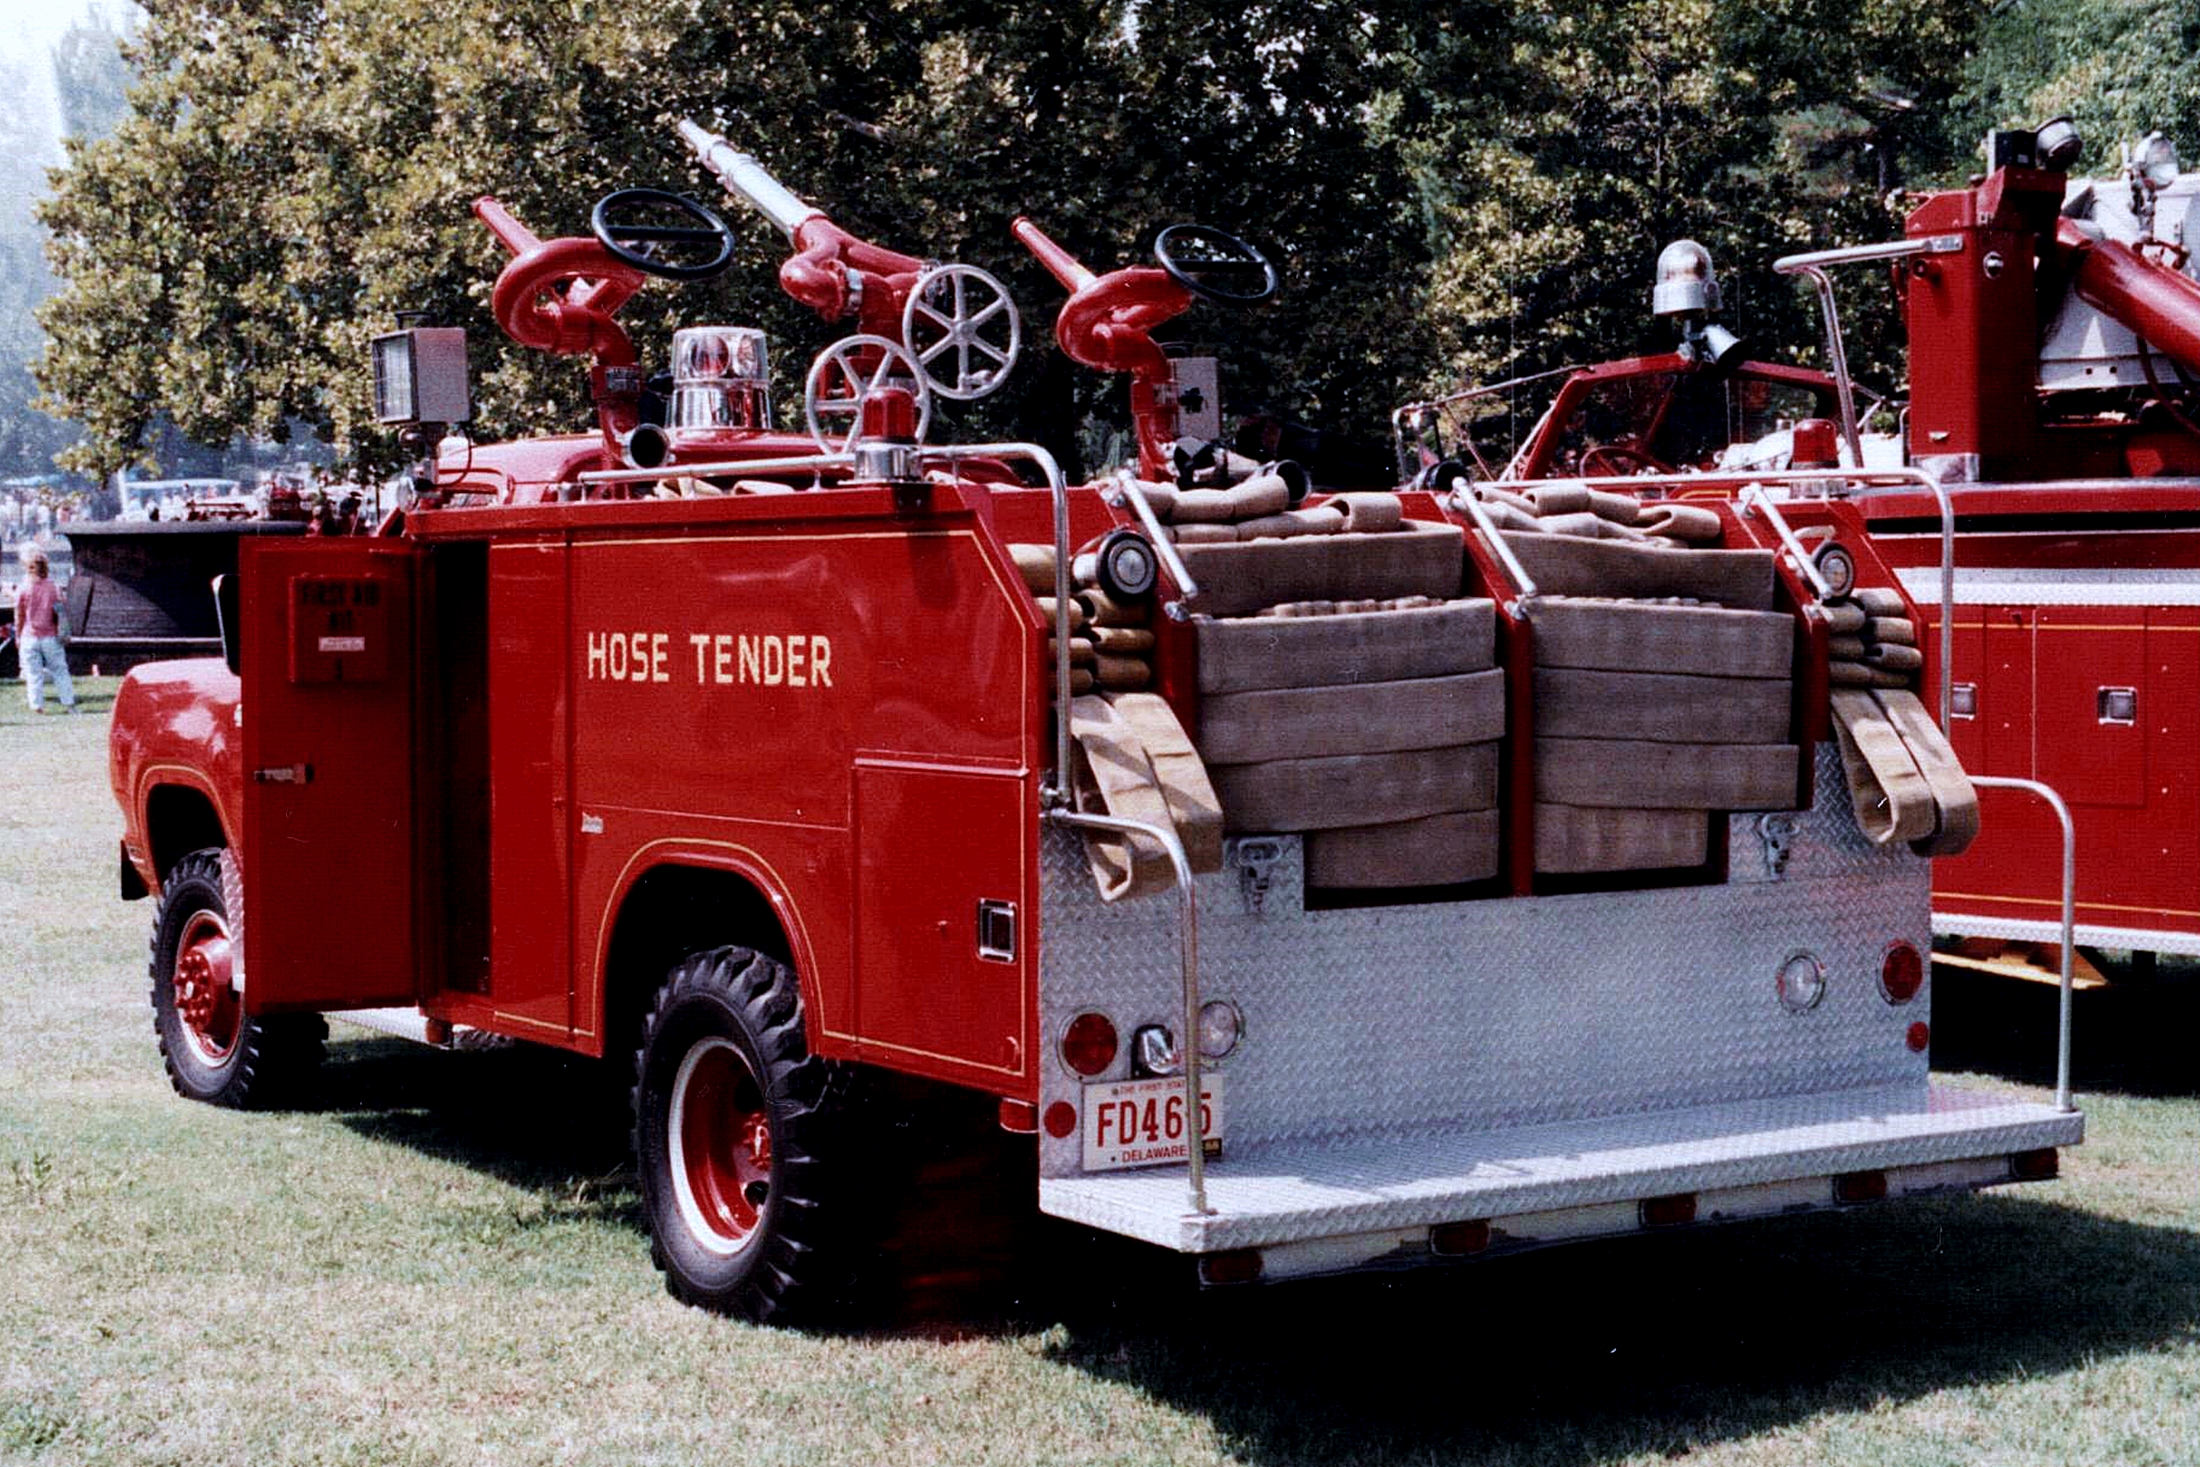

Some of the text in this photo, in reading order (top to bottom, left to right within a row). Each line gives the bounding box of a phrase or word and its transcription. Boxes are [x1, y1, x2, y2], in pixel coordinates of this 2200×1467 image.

[588, 632, 833, 687] HOSE TENDER
[1122, 1145, 1187, 1163] DELAWARE
